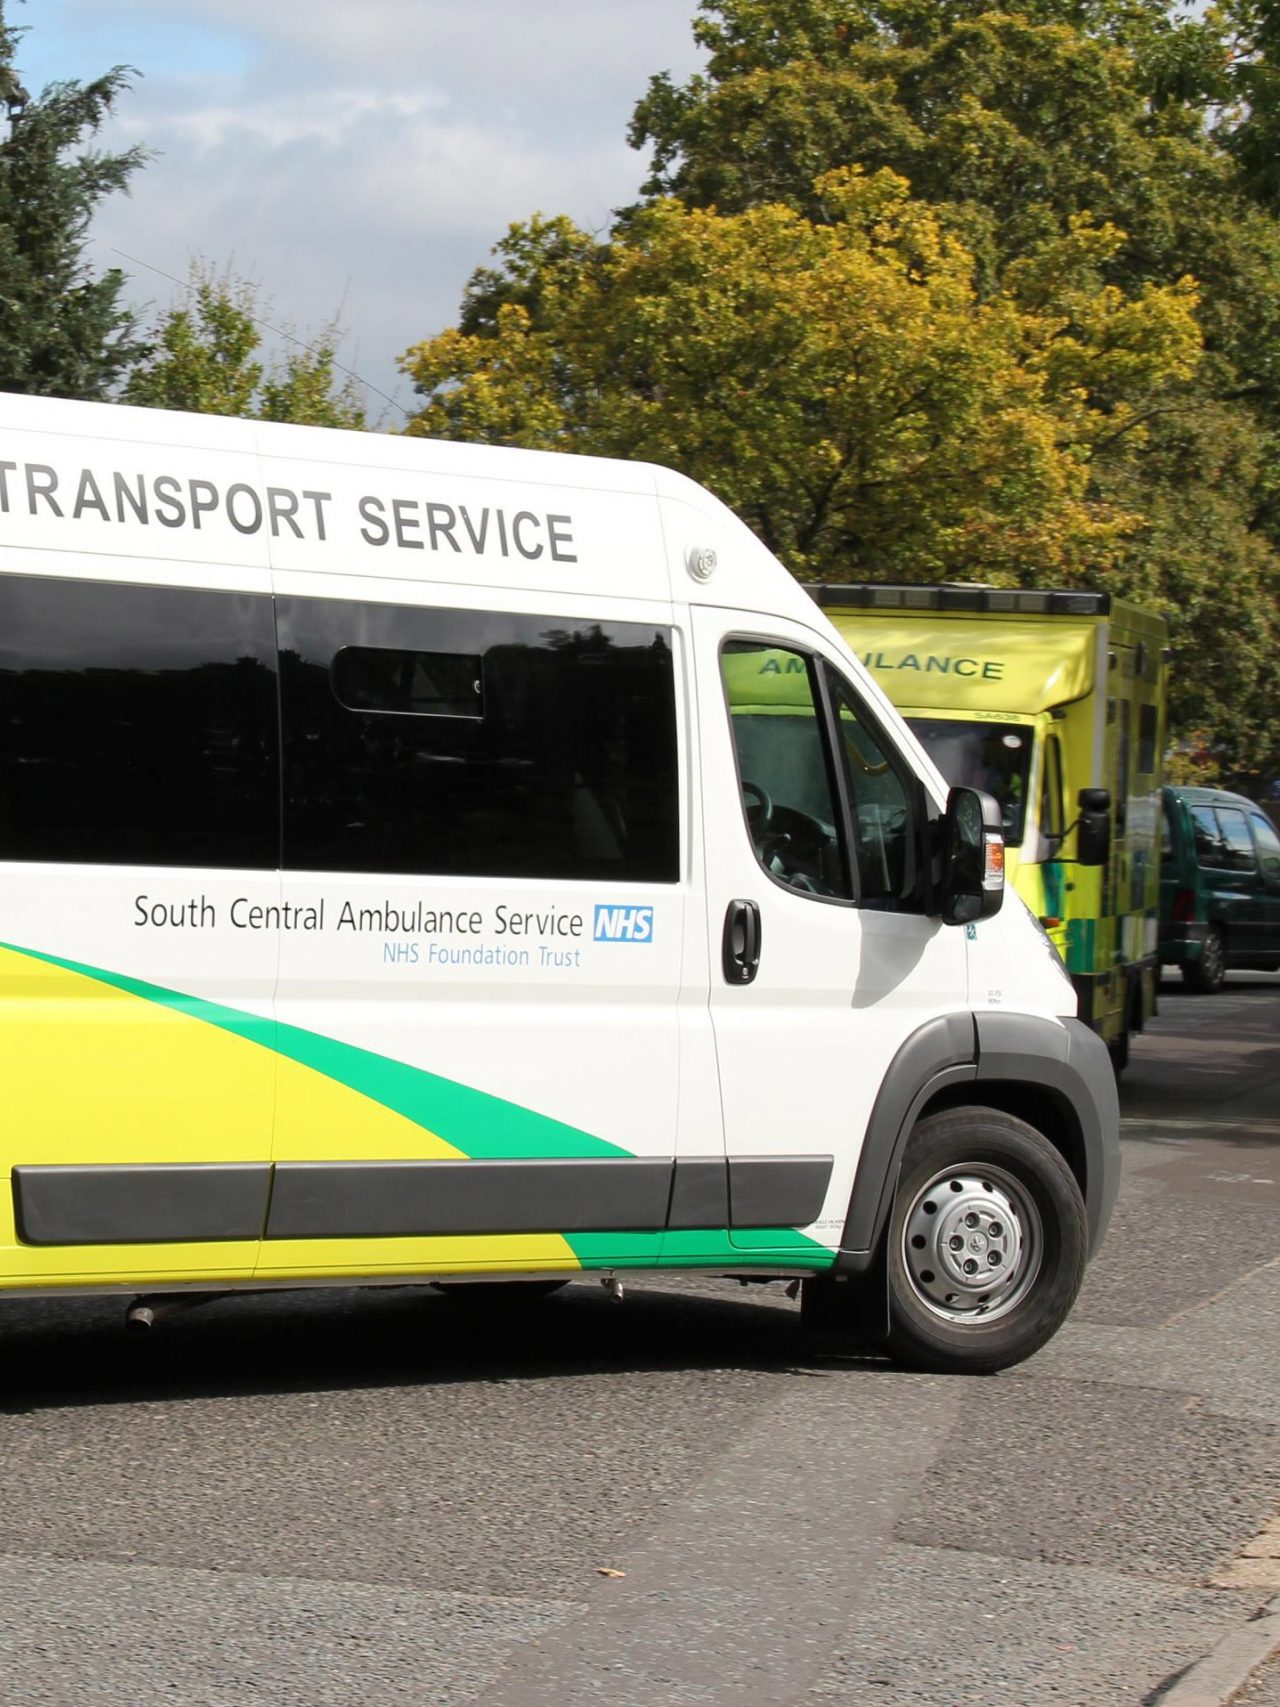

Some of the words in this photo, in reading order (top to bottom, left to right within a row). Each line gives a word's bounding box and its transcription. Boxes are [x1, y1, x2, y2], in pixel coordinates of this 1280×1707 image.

[358, 496, 578, 563] SERVICE
[758, 652, 1005, 680] AMLANCE
[134, 895, 216, 928] South
[230, 898, 324, 930] Central
[336, 900, 483, 934] Ambulance
[494, 905, 584, 937] Service
[595, 907, 652, 940] NHS
[383, 942, 419, 964] NHS
[428, 944, 529, 966] Foundation
[538, 946, 581, 967] Trust
